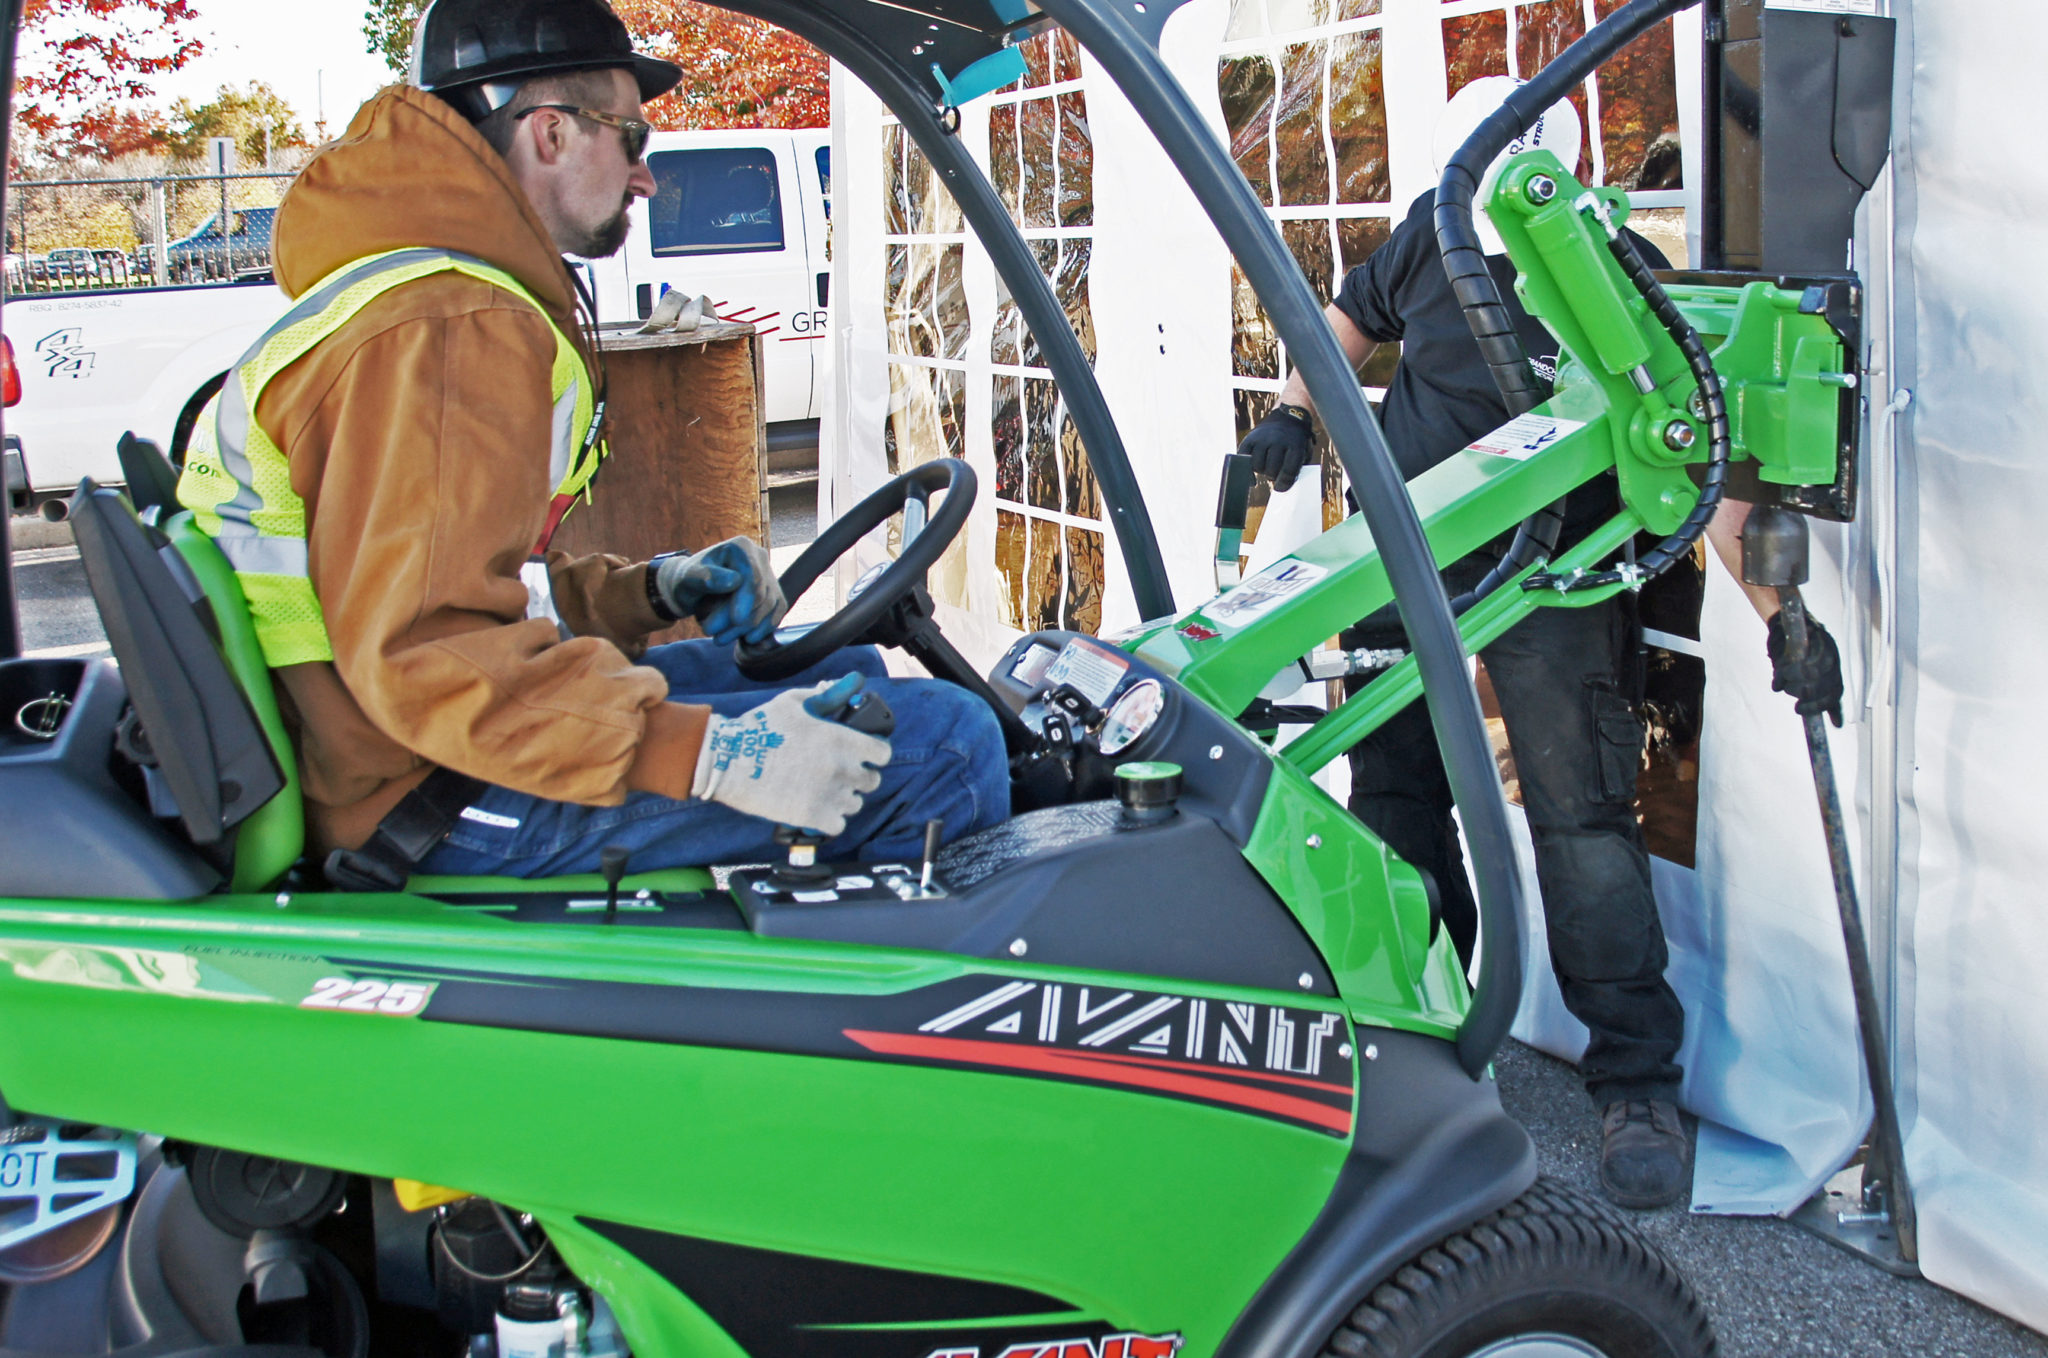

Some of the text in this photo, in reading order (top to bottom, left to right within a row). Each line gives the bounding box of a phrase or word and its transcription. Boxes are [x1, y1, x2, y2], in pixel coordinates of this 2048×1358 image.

[230, 948, 322, 964] INJECTION
[300, 975, 429, 1016] 225
[918, 980, 1341, 1076] AVANT
